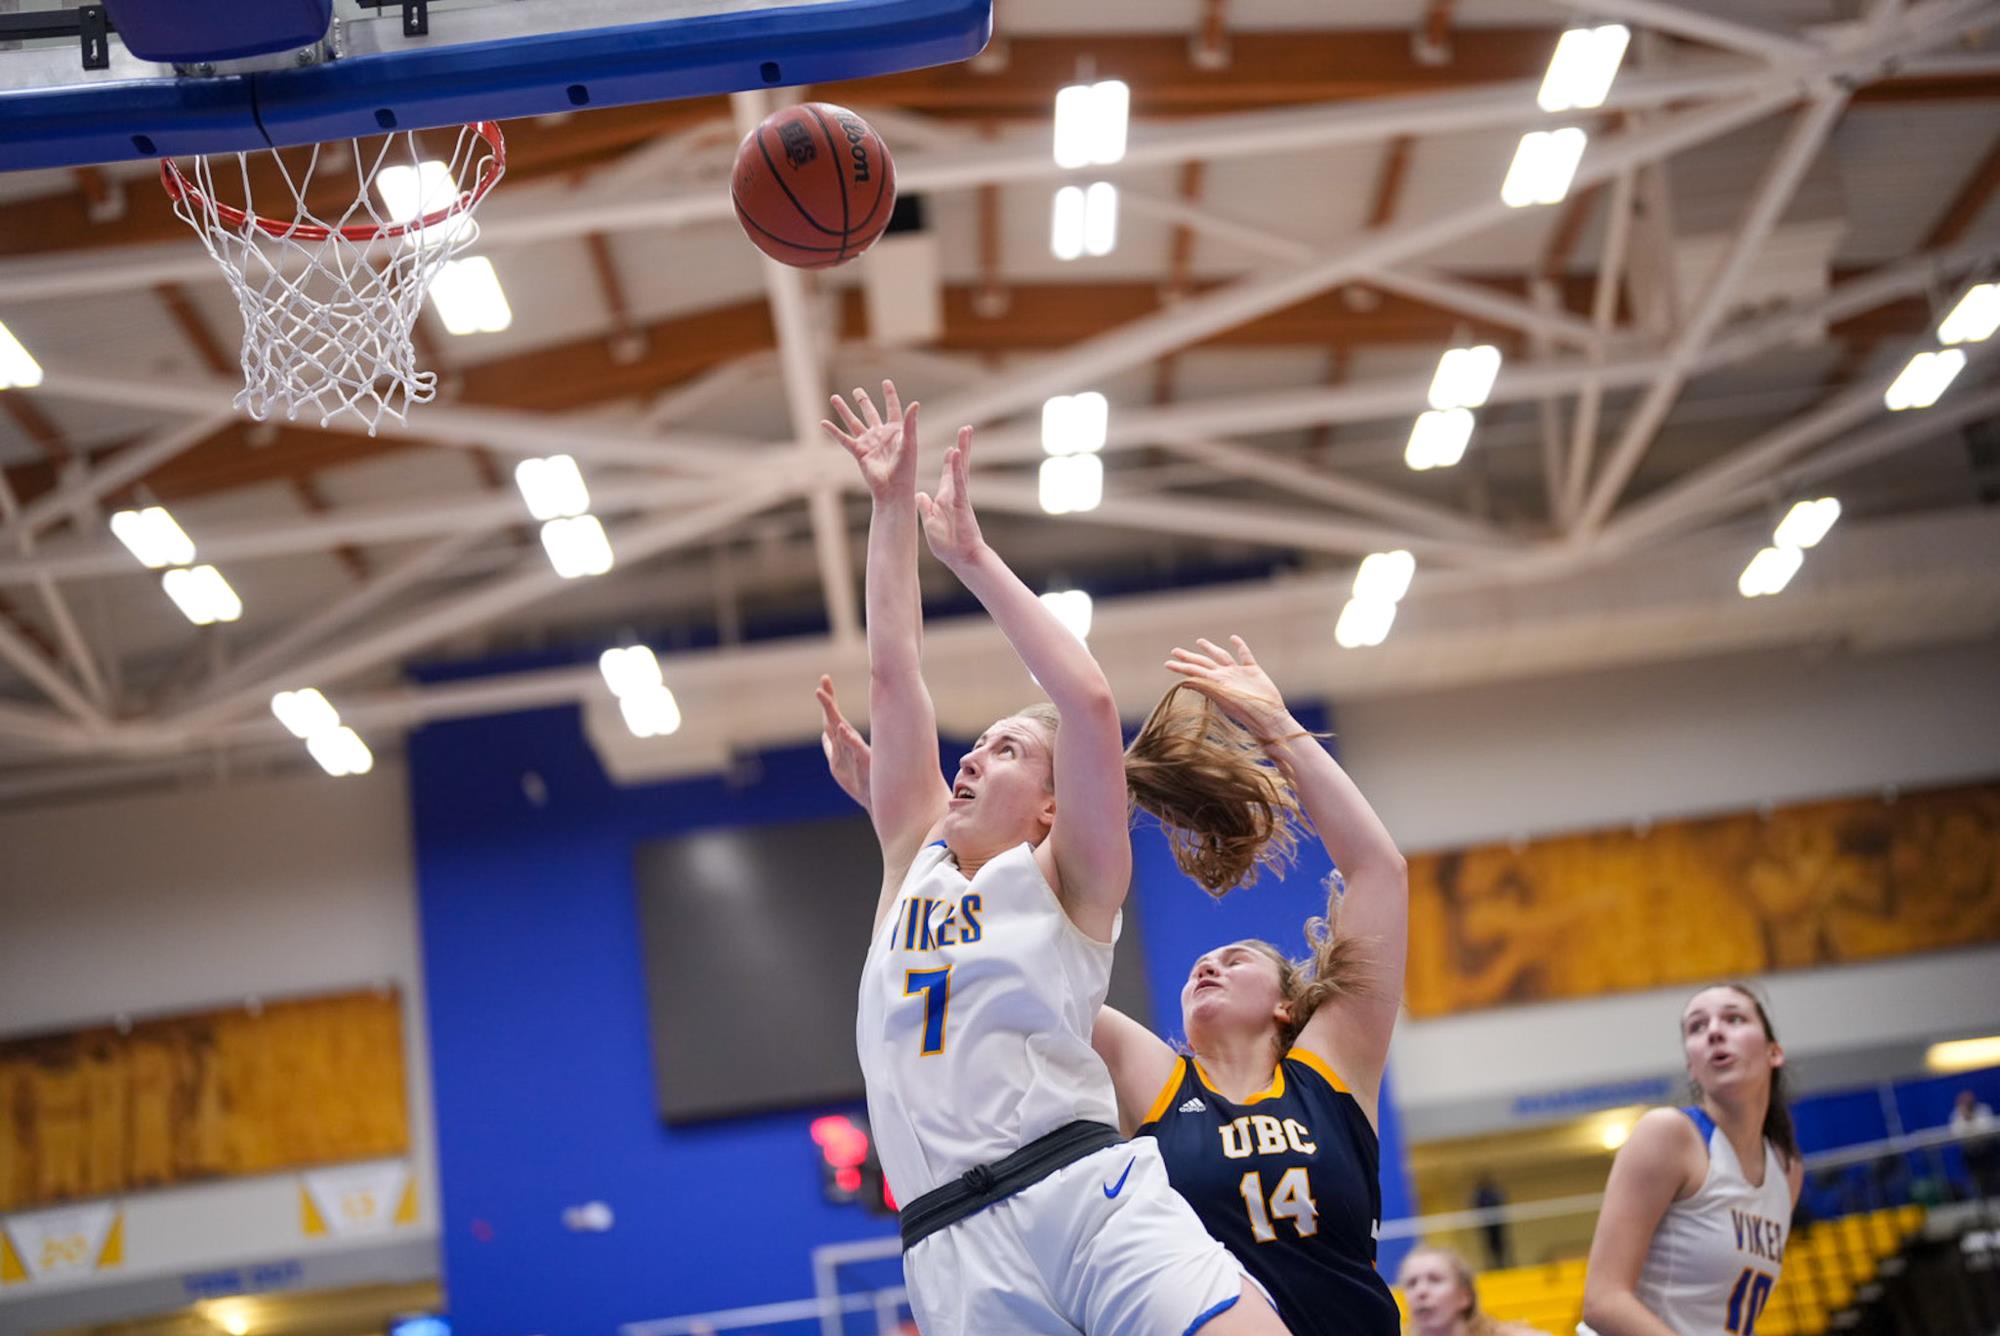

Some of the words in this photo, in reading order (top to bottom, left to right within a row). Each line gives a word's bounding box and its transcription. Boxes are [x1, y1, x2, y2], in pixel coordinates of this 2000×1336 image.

[838, 114, 871, 183] lson
[903, 964, 953, 1057] 7
[1218, 1114, 1317, 1159] UBC
[1239, 1166, 1319, 1244] 14
